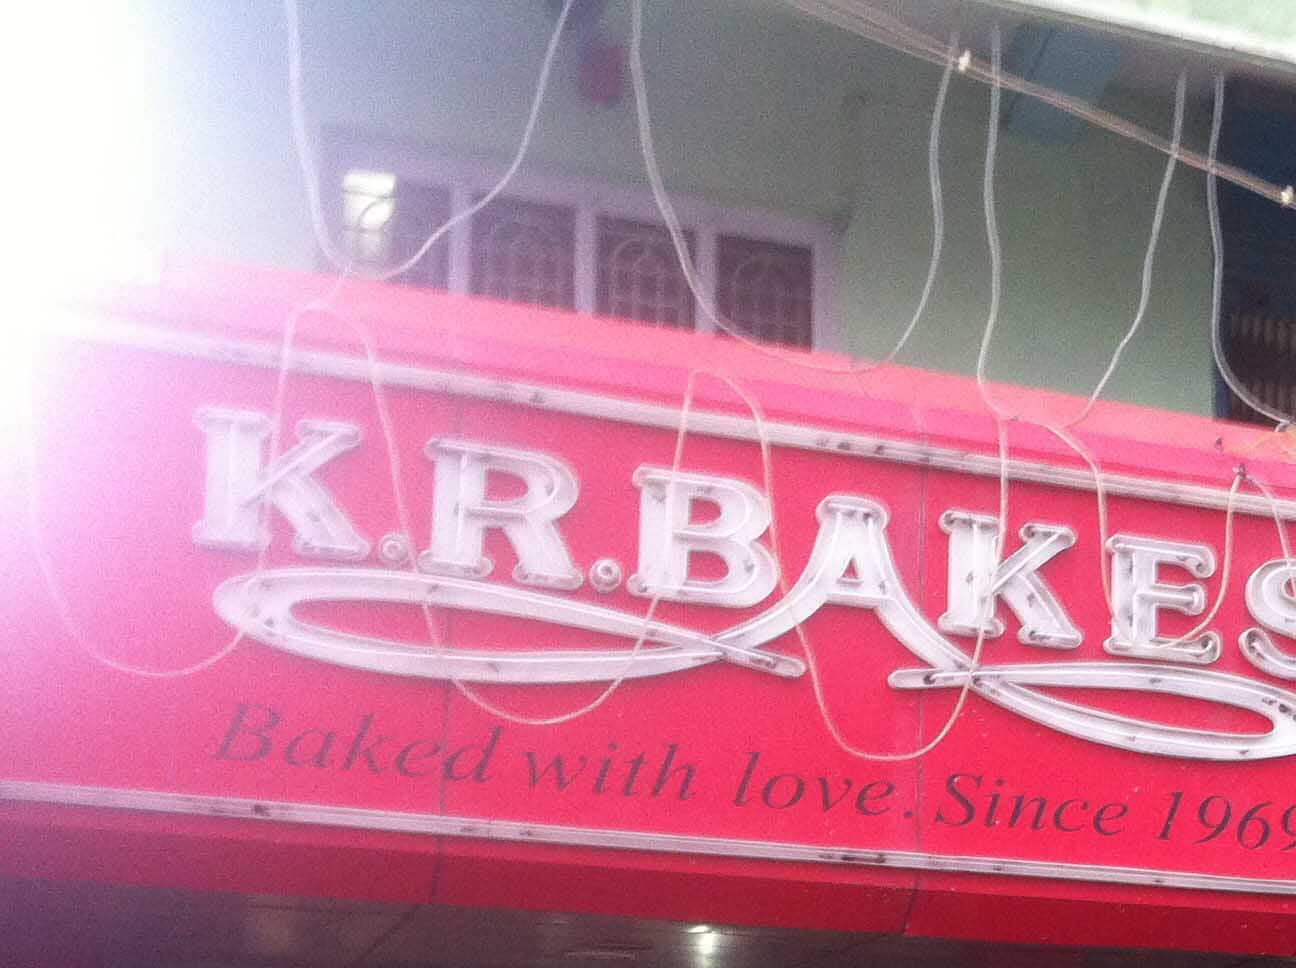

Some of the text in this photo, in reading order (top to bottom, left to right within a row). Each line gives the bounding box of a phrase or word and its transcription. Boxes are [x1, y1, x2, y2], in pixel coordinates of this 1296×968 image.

[215, 702, 503, 784] Baked
[523, 741, 699, 801] with
[934, 772, 1130, 836] Since
